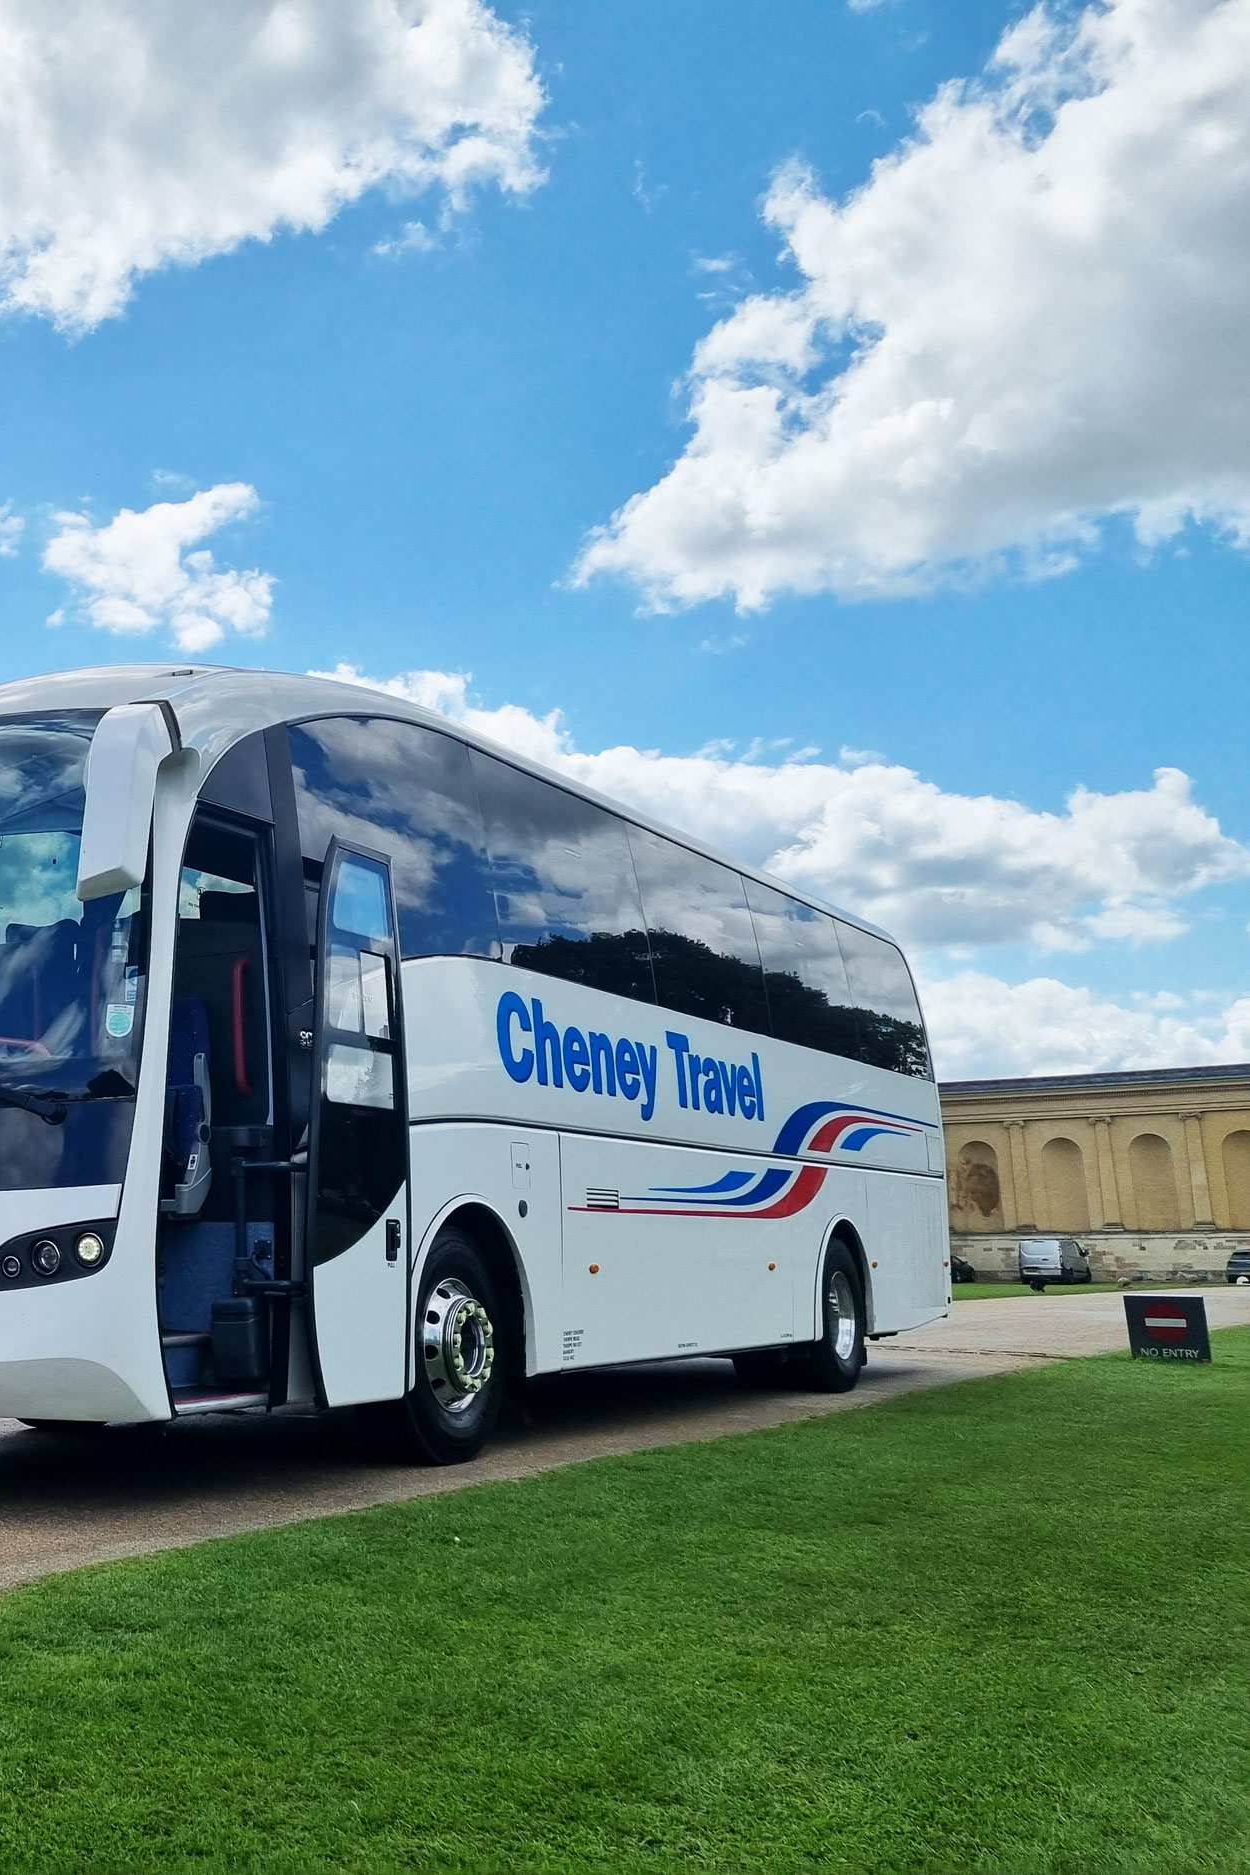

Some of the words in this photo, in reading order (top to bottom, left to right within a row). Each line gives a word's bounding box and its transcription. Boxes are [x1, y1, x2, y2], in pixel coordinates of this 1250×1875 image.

[497, 991, 657, 1121] Cheney
[665, 1030, 764, 1122] Travel
[1140, 1347, 1159, 1357] NO
[1162, 1348, 1200, 1359] ENTRY
